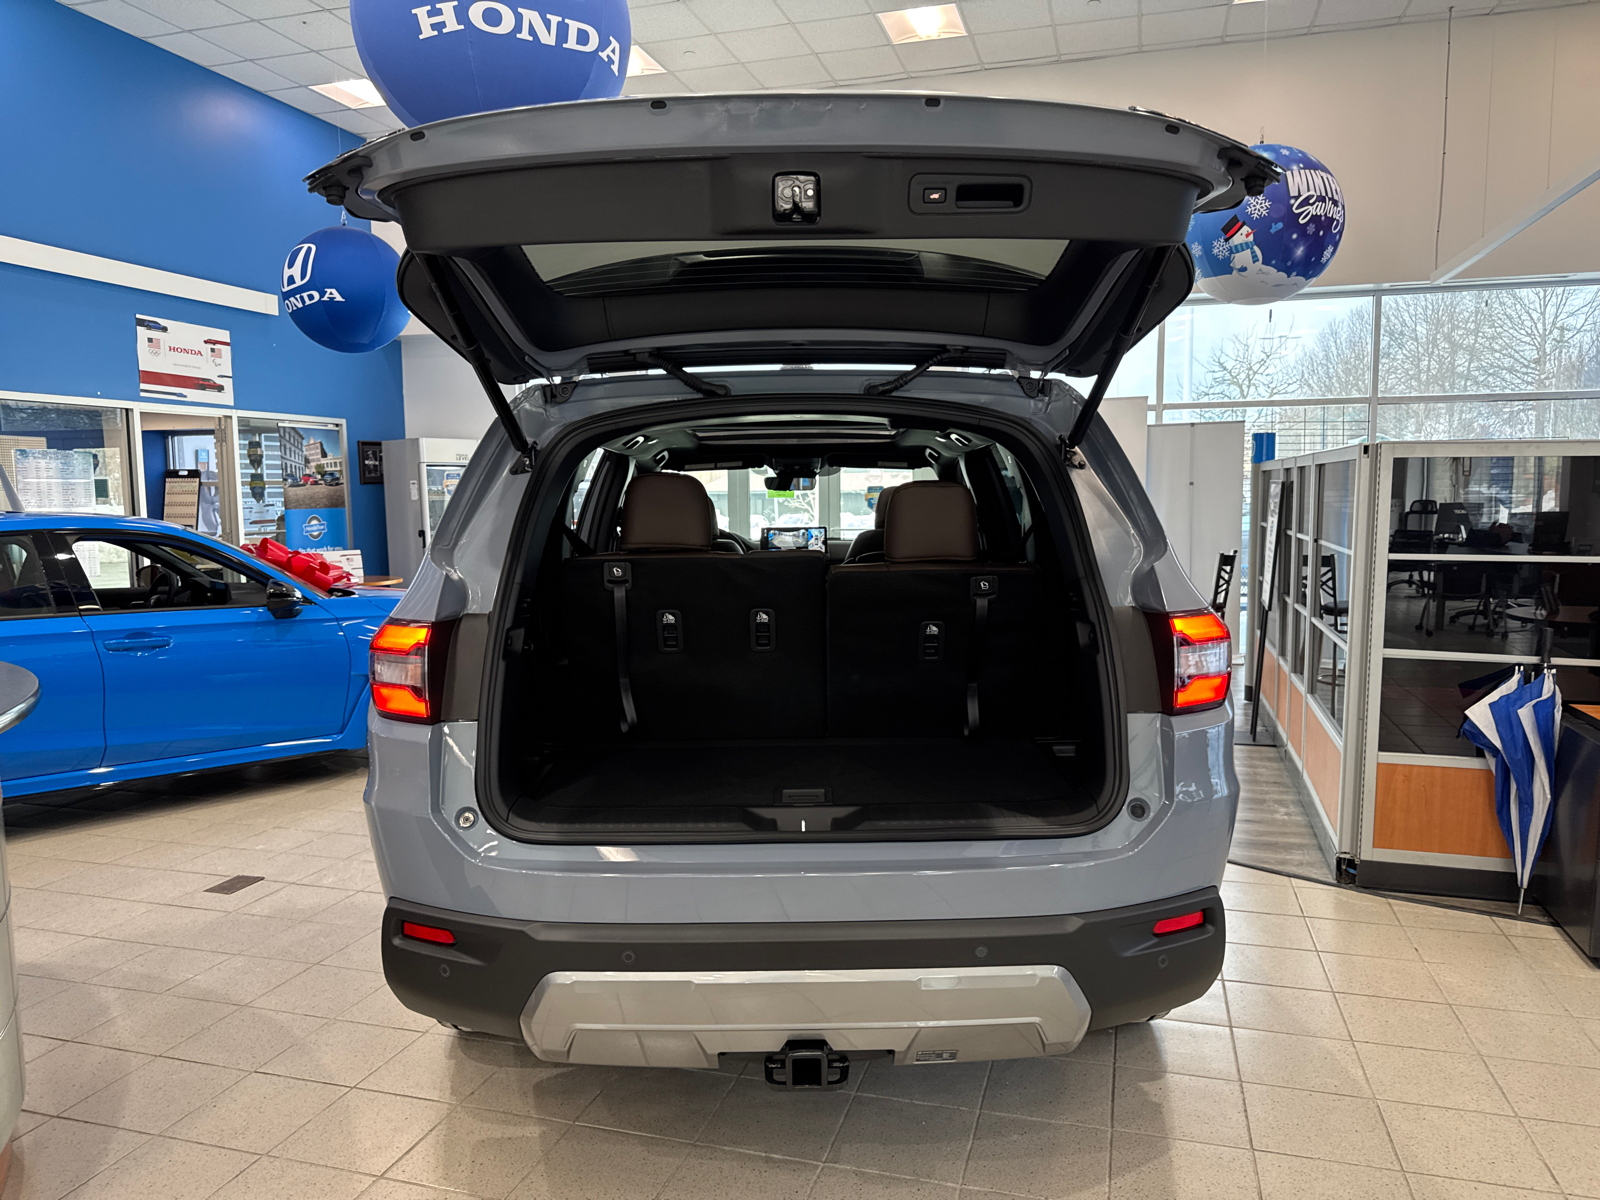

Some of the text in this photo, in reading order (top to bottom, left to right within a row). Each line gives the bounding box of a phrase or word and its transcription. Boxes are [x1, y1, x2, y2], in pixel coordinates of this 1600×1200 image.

[411, 0, 620, 77] HONDA
[285, 288, 346, 313] ONDA
[168, 345, 204, 357] HONDA
